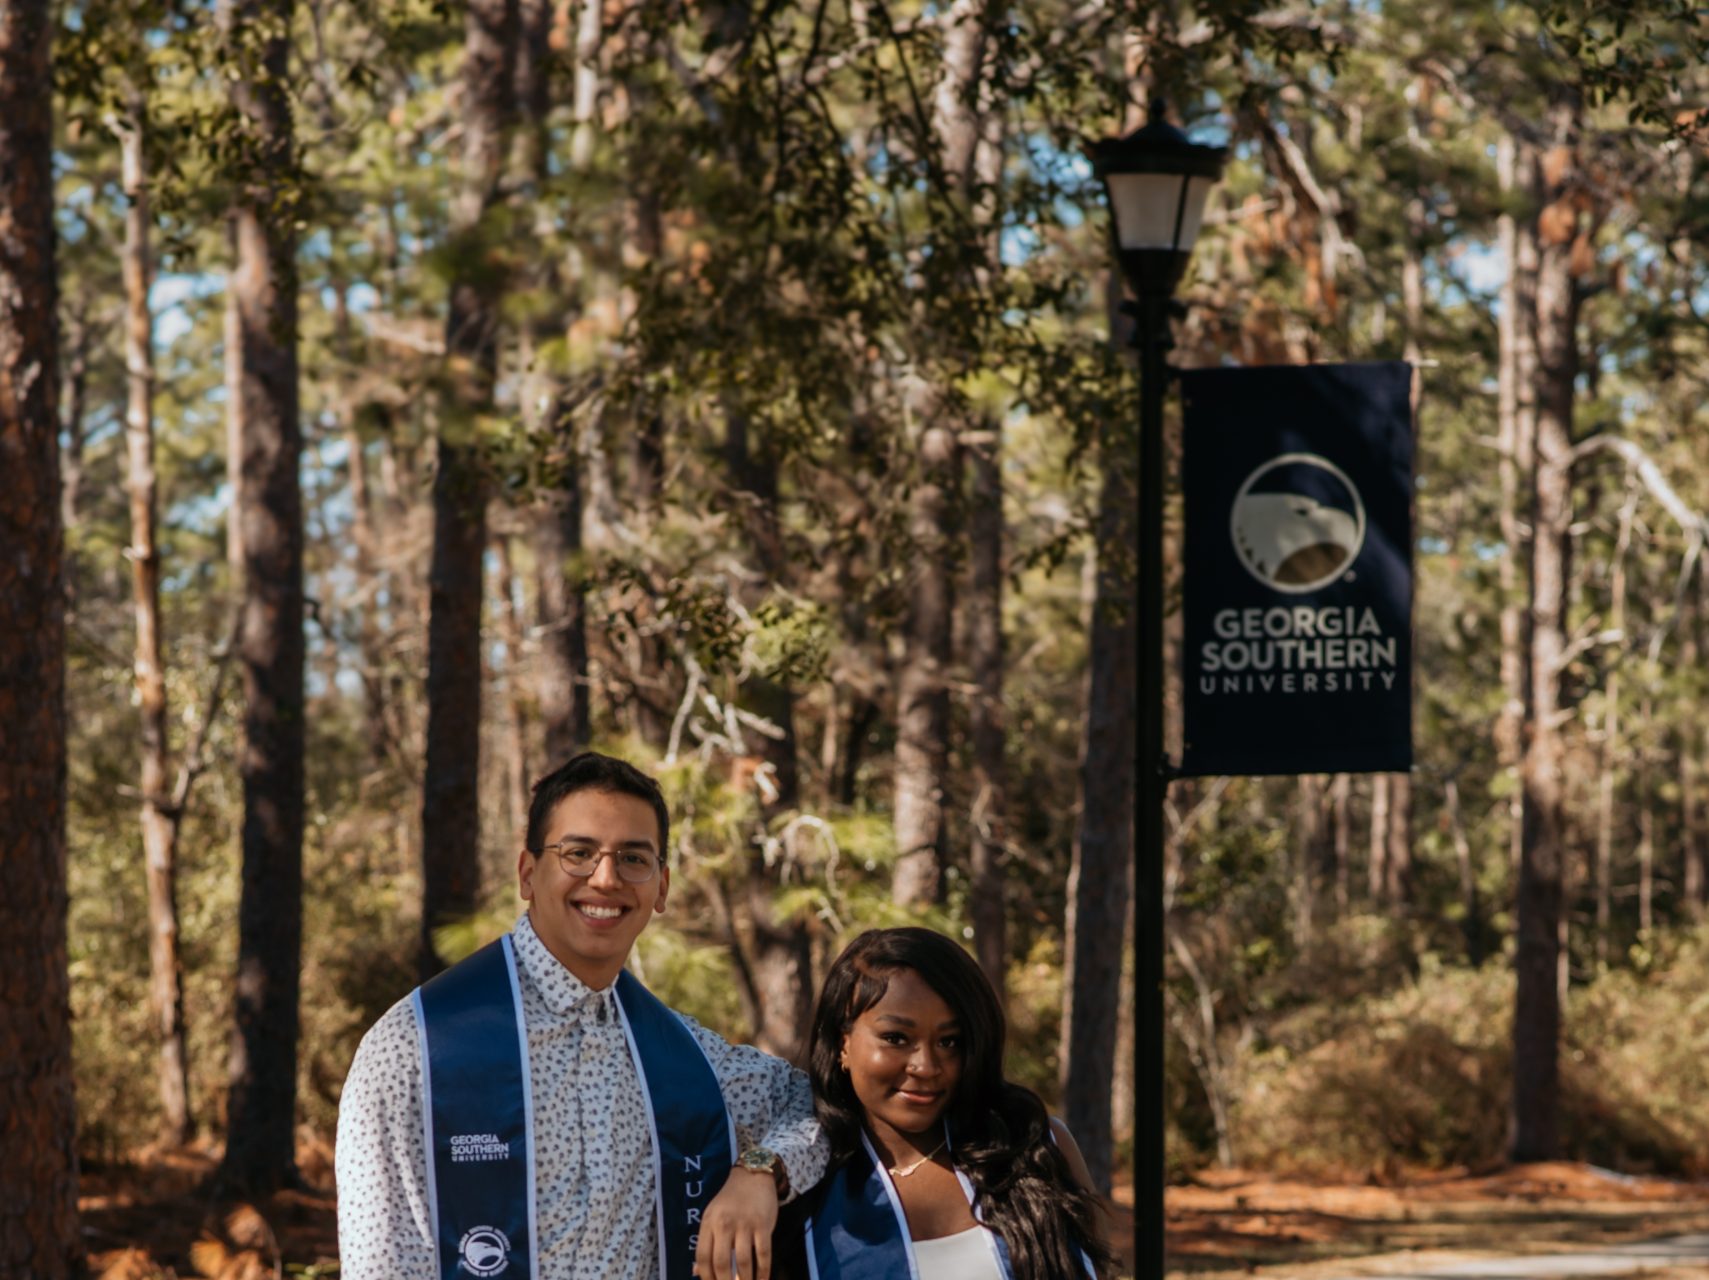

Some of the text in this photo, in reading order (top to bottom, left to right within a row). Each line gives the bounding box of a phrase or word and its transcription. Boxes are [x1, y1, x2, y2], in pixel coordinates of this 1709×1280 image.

[1213, 606, 1382, 639] GEORGIA
[1201, 637, 1397, 672] SOUTHERN
[1199, 671, 1398, 695] UNIVERSITY
[450, 1133, 500, 1146] GEORGIA
[451, 1143, 510, 1156] SOUTHERN
